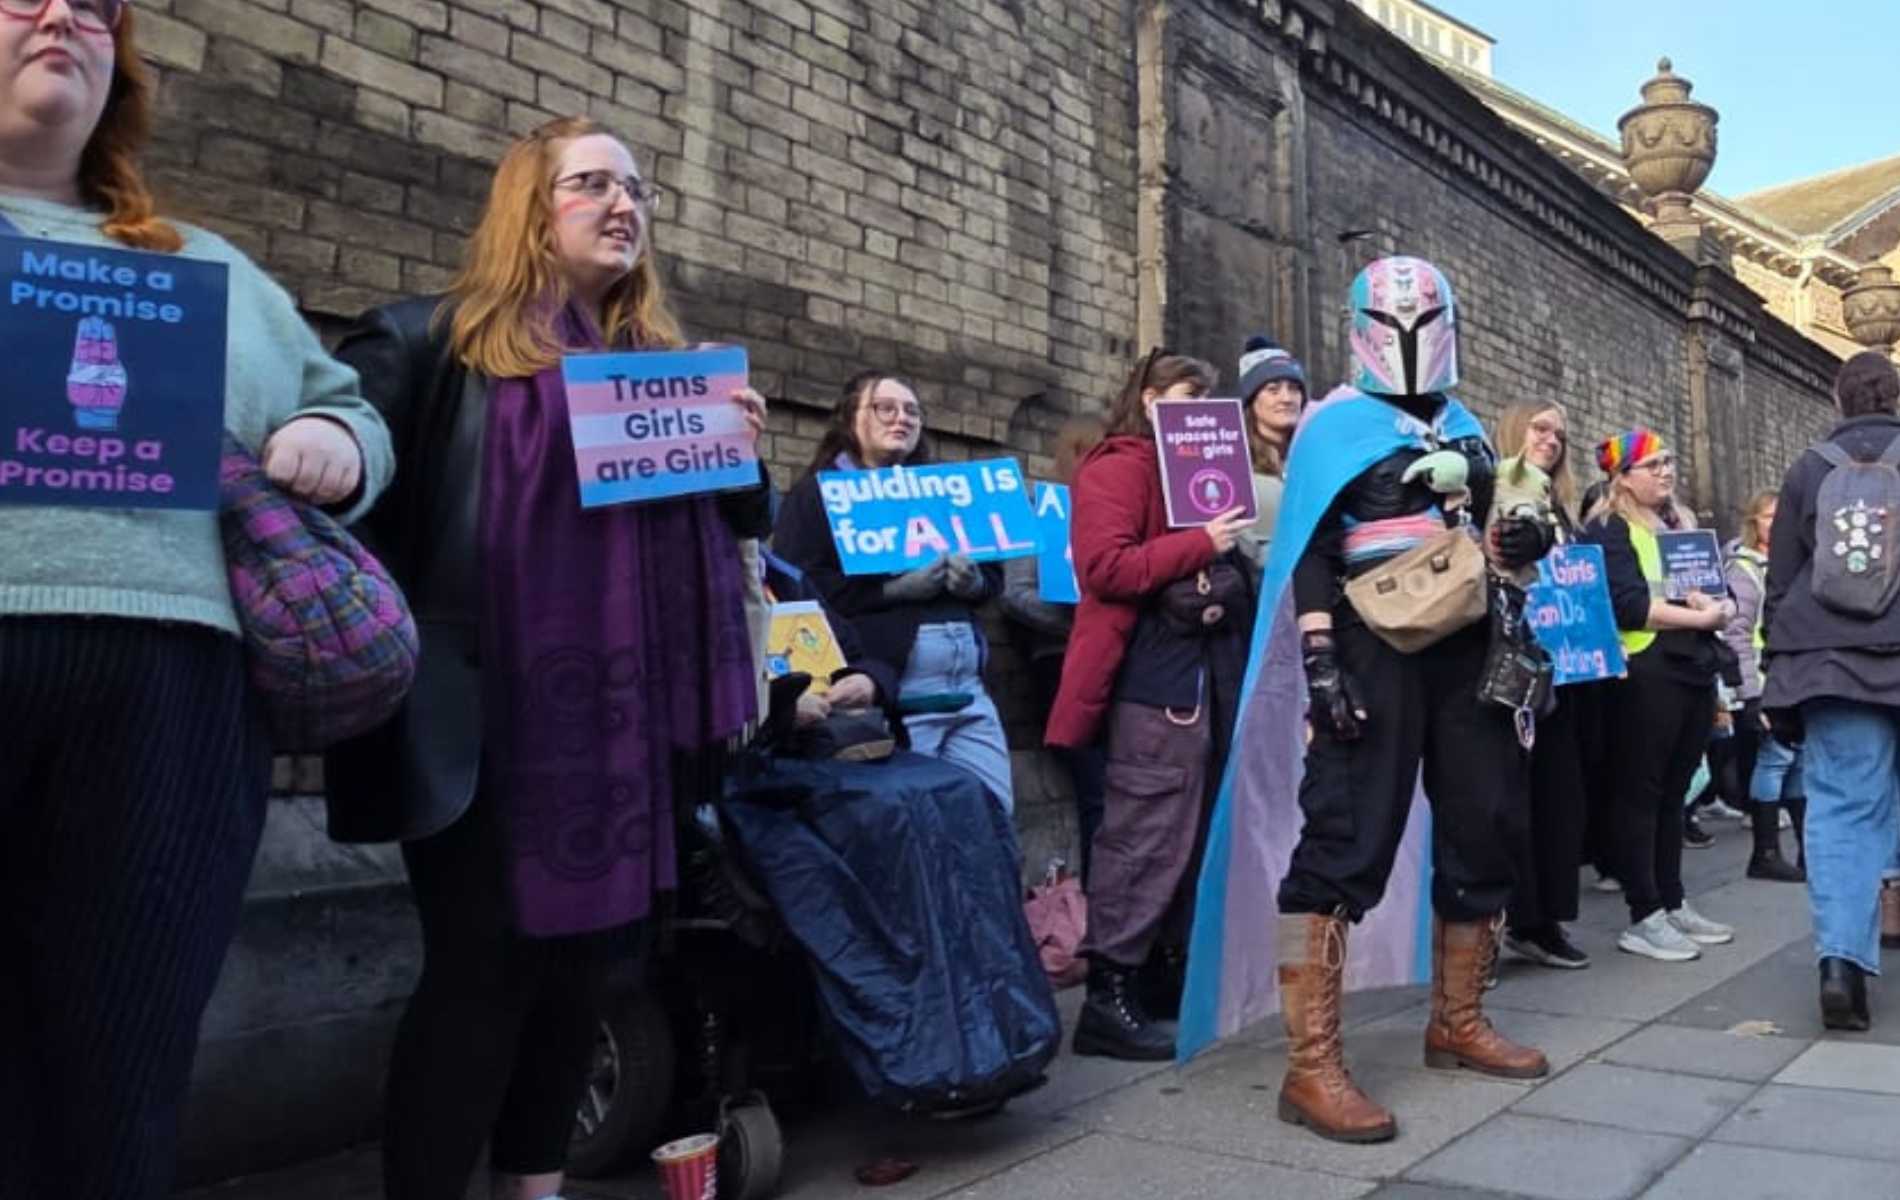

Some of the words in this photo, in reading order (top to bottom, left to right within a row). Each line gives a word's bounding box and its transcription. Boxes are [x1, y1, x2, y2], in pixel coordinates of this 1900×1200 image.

[21, 250, 137, 286] Make
[147, 270, 174, 292] a
[11, 281, 183, 323] Promise
[606, 373, 709, 401] Trans
[625, 407, 705, 440] Girls
[17, 427, 126, 464] Keep
[135, 439, 163, 461] a
[597, 456, 657, 483] are
[665, 443, 742, 475] Girls
[0, 460, 174, 493] Promise
[834, 518, 898, 555] for
[905, 511, 1035, 558] ALL
